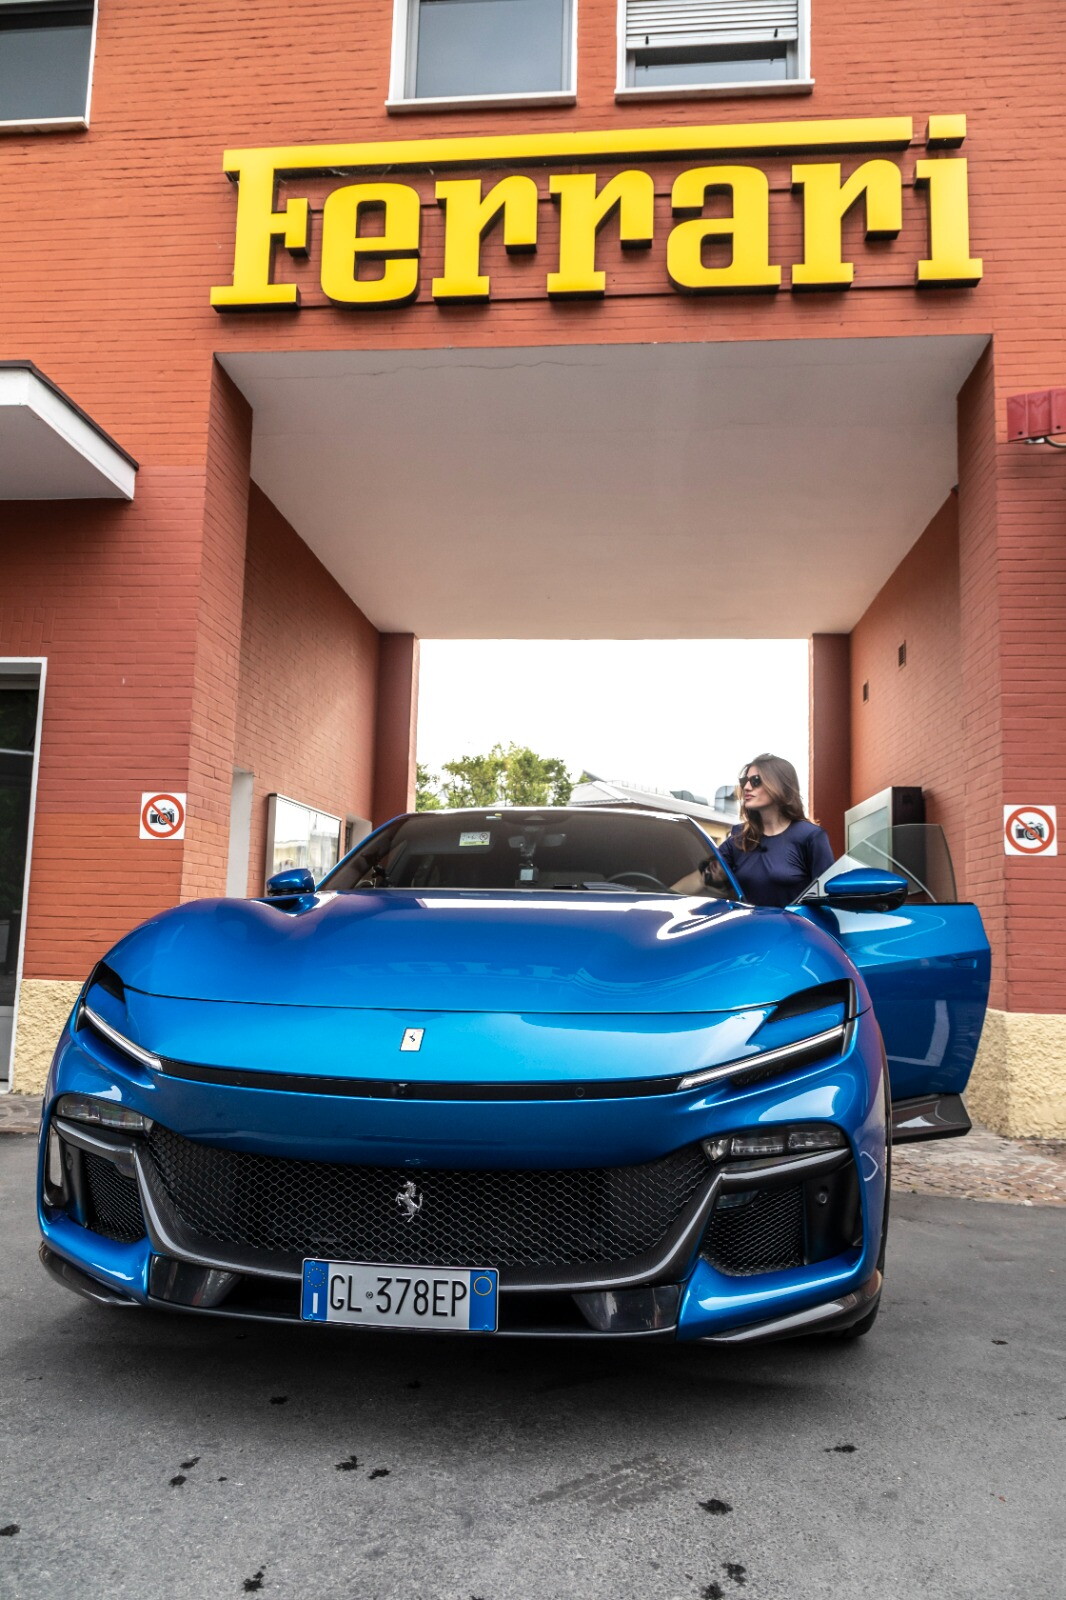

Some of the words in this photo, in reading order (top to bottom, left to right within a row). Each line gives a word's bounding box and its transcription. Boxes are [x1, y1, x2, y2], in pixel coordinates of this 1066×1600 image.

[210, 113, 983, 310] Ferrari
[330, 1274, 362, 1312] GL
[376, 1277, 467, 1317] 378EP
